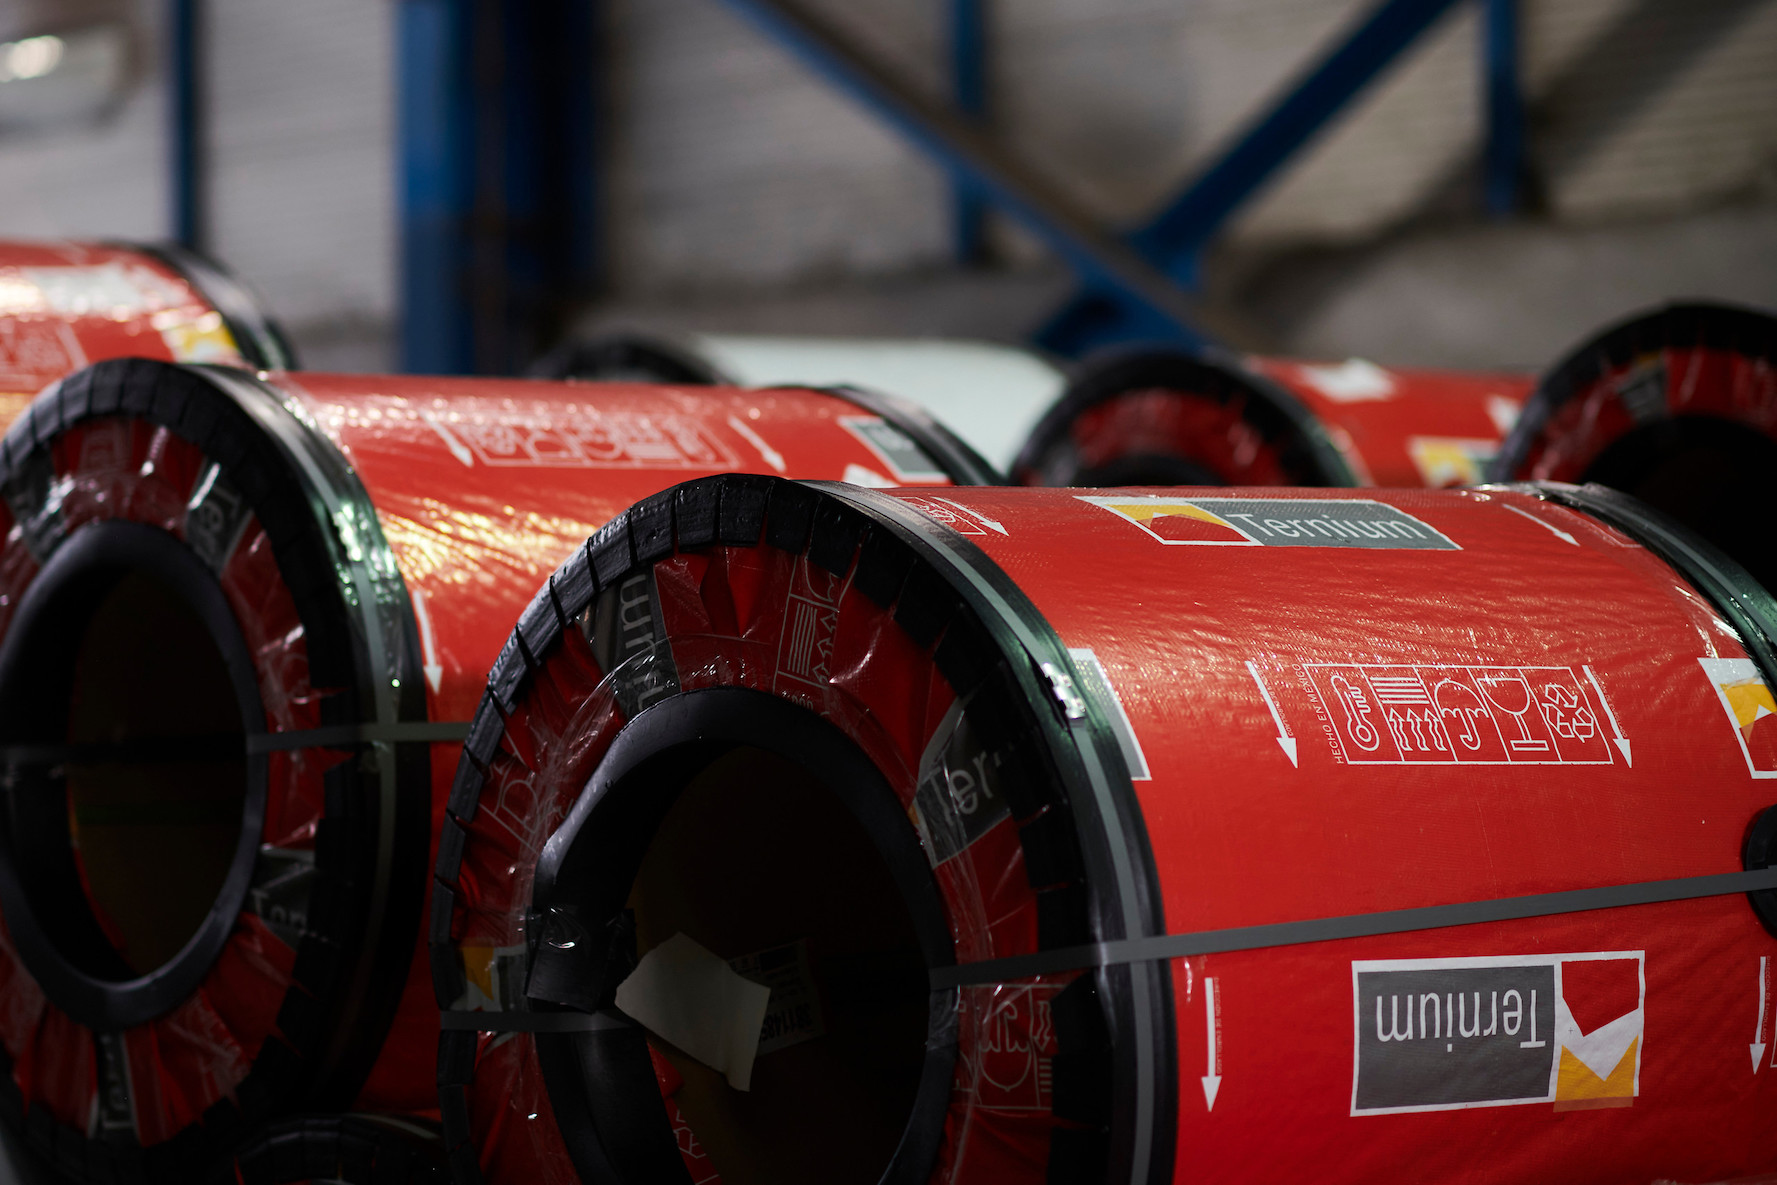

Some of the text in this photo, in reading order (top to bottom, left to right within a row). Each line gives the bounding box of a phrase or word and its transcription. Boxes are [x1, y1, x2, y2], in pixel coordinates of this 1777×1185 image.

[1226, 513, 1427, 540] Ternium
[1312, 704, 1328, 721] EN
[1322, 724, 1345, 764] HECHO
[920, 749, 1002, 827] Ter
[1376, 989, 1546, 1052] Ternium
